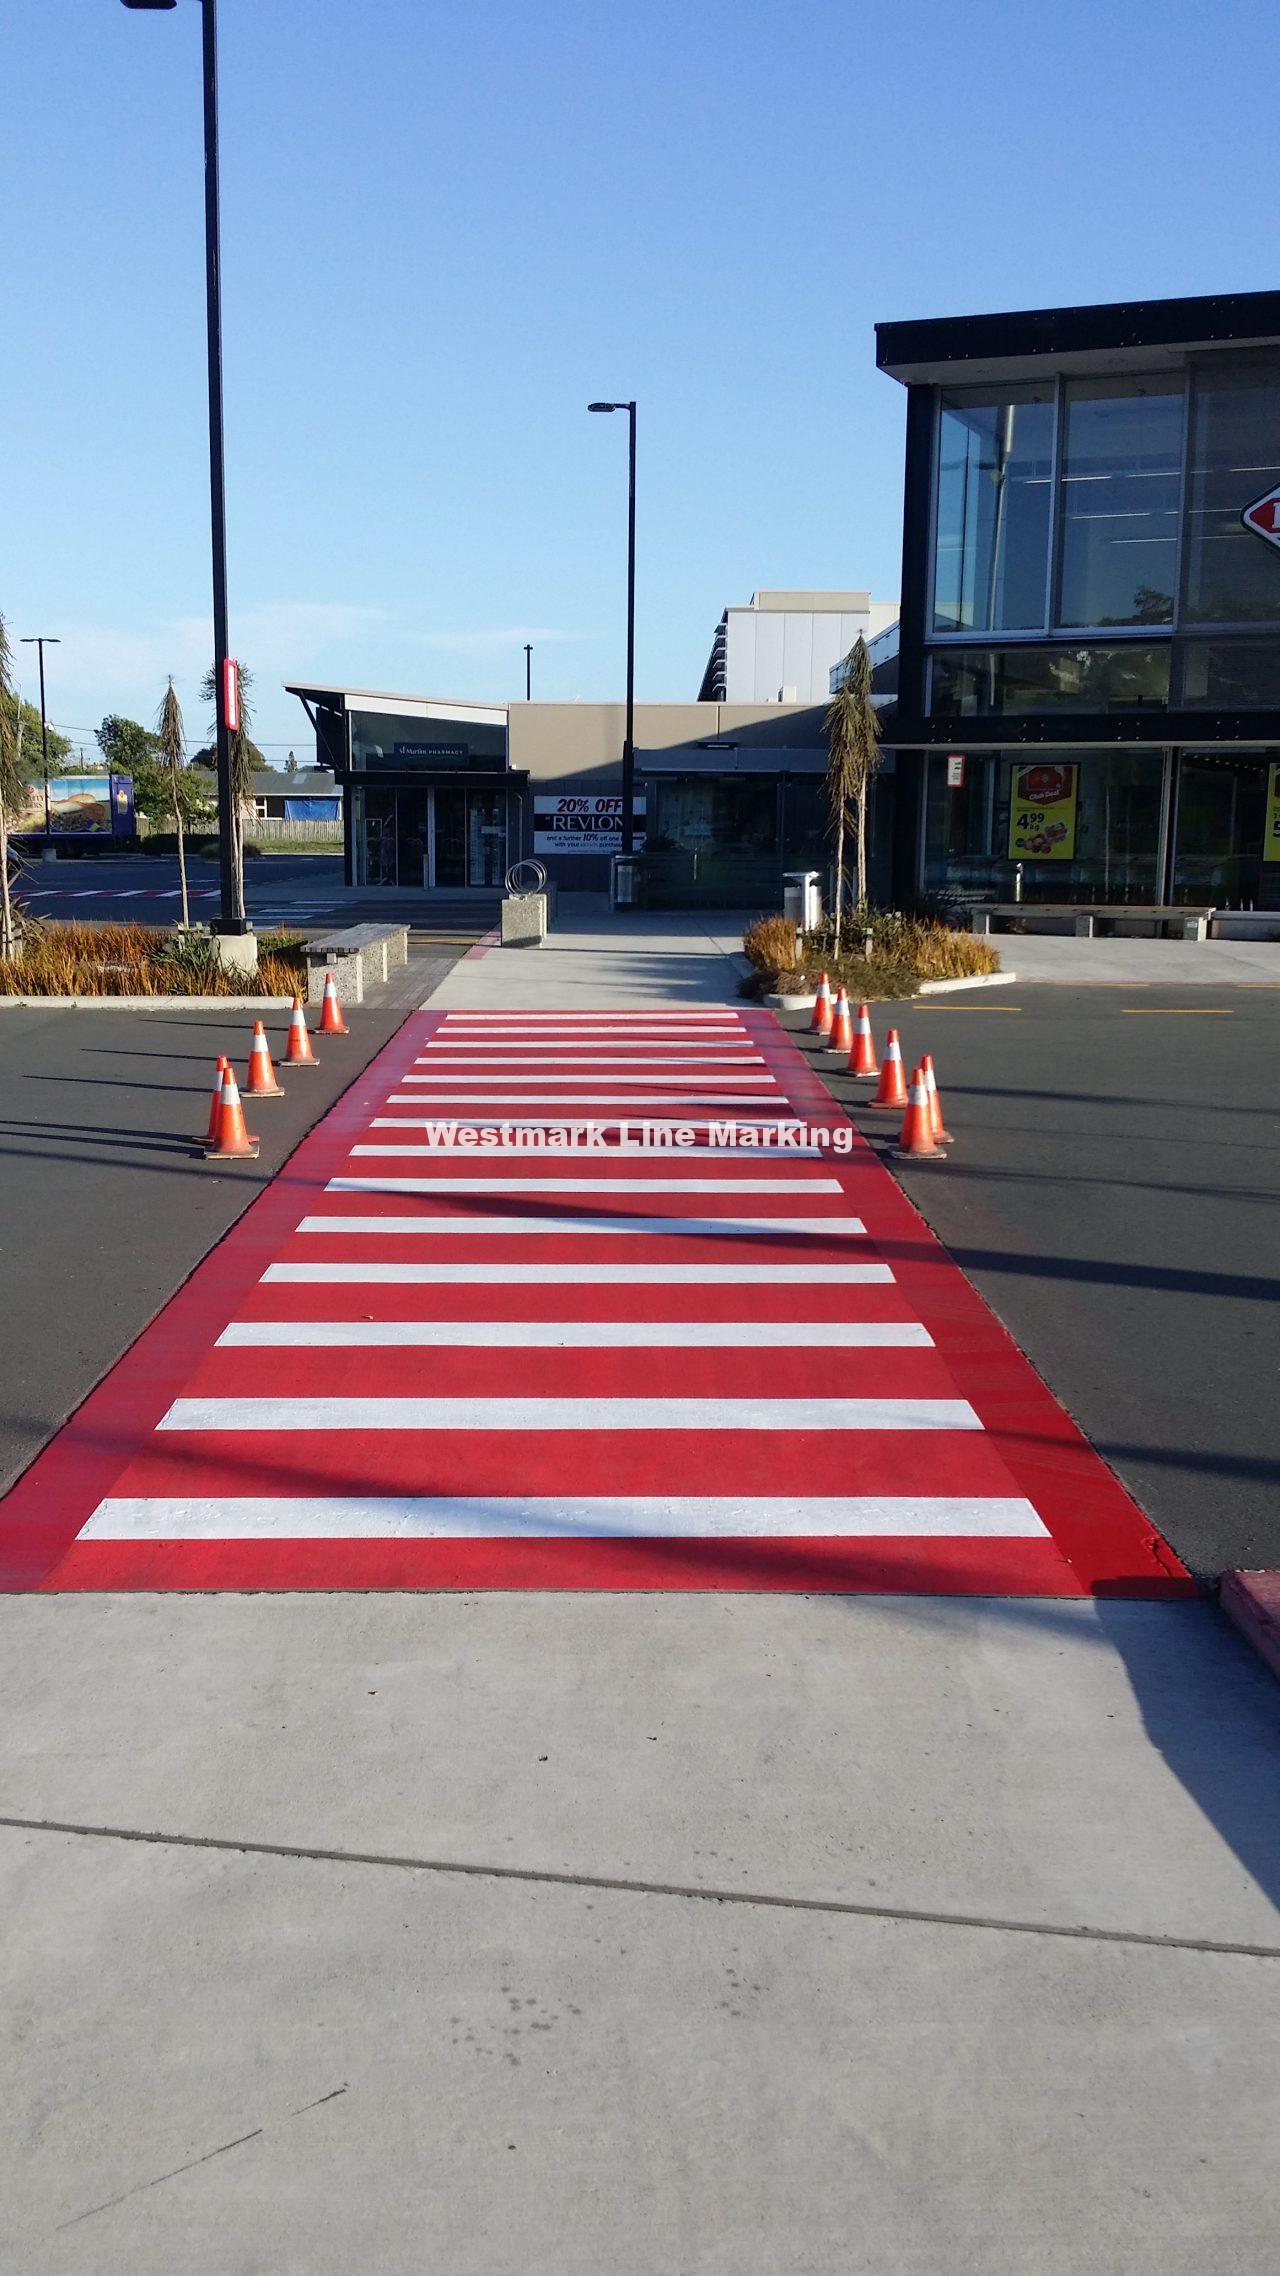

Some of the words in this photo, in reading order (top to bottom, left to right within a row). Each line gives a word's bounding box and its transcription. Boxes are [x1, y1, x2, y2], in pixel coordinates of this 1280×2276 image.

[557, 798, 589, 813] 20%
[595, 798, 623, 813] OFF
[553, 815, 623, 831] REVLON
[583, 833, 599, 842] 10%
